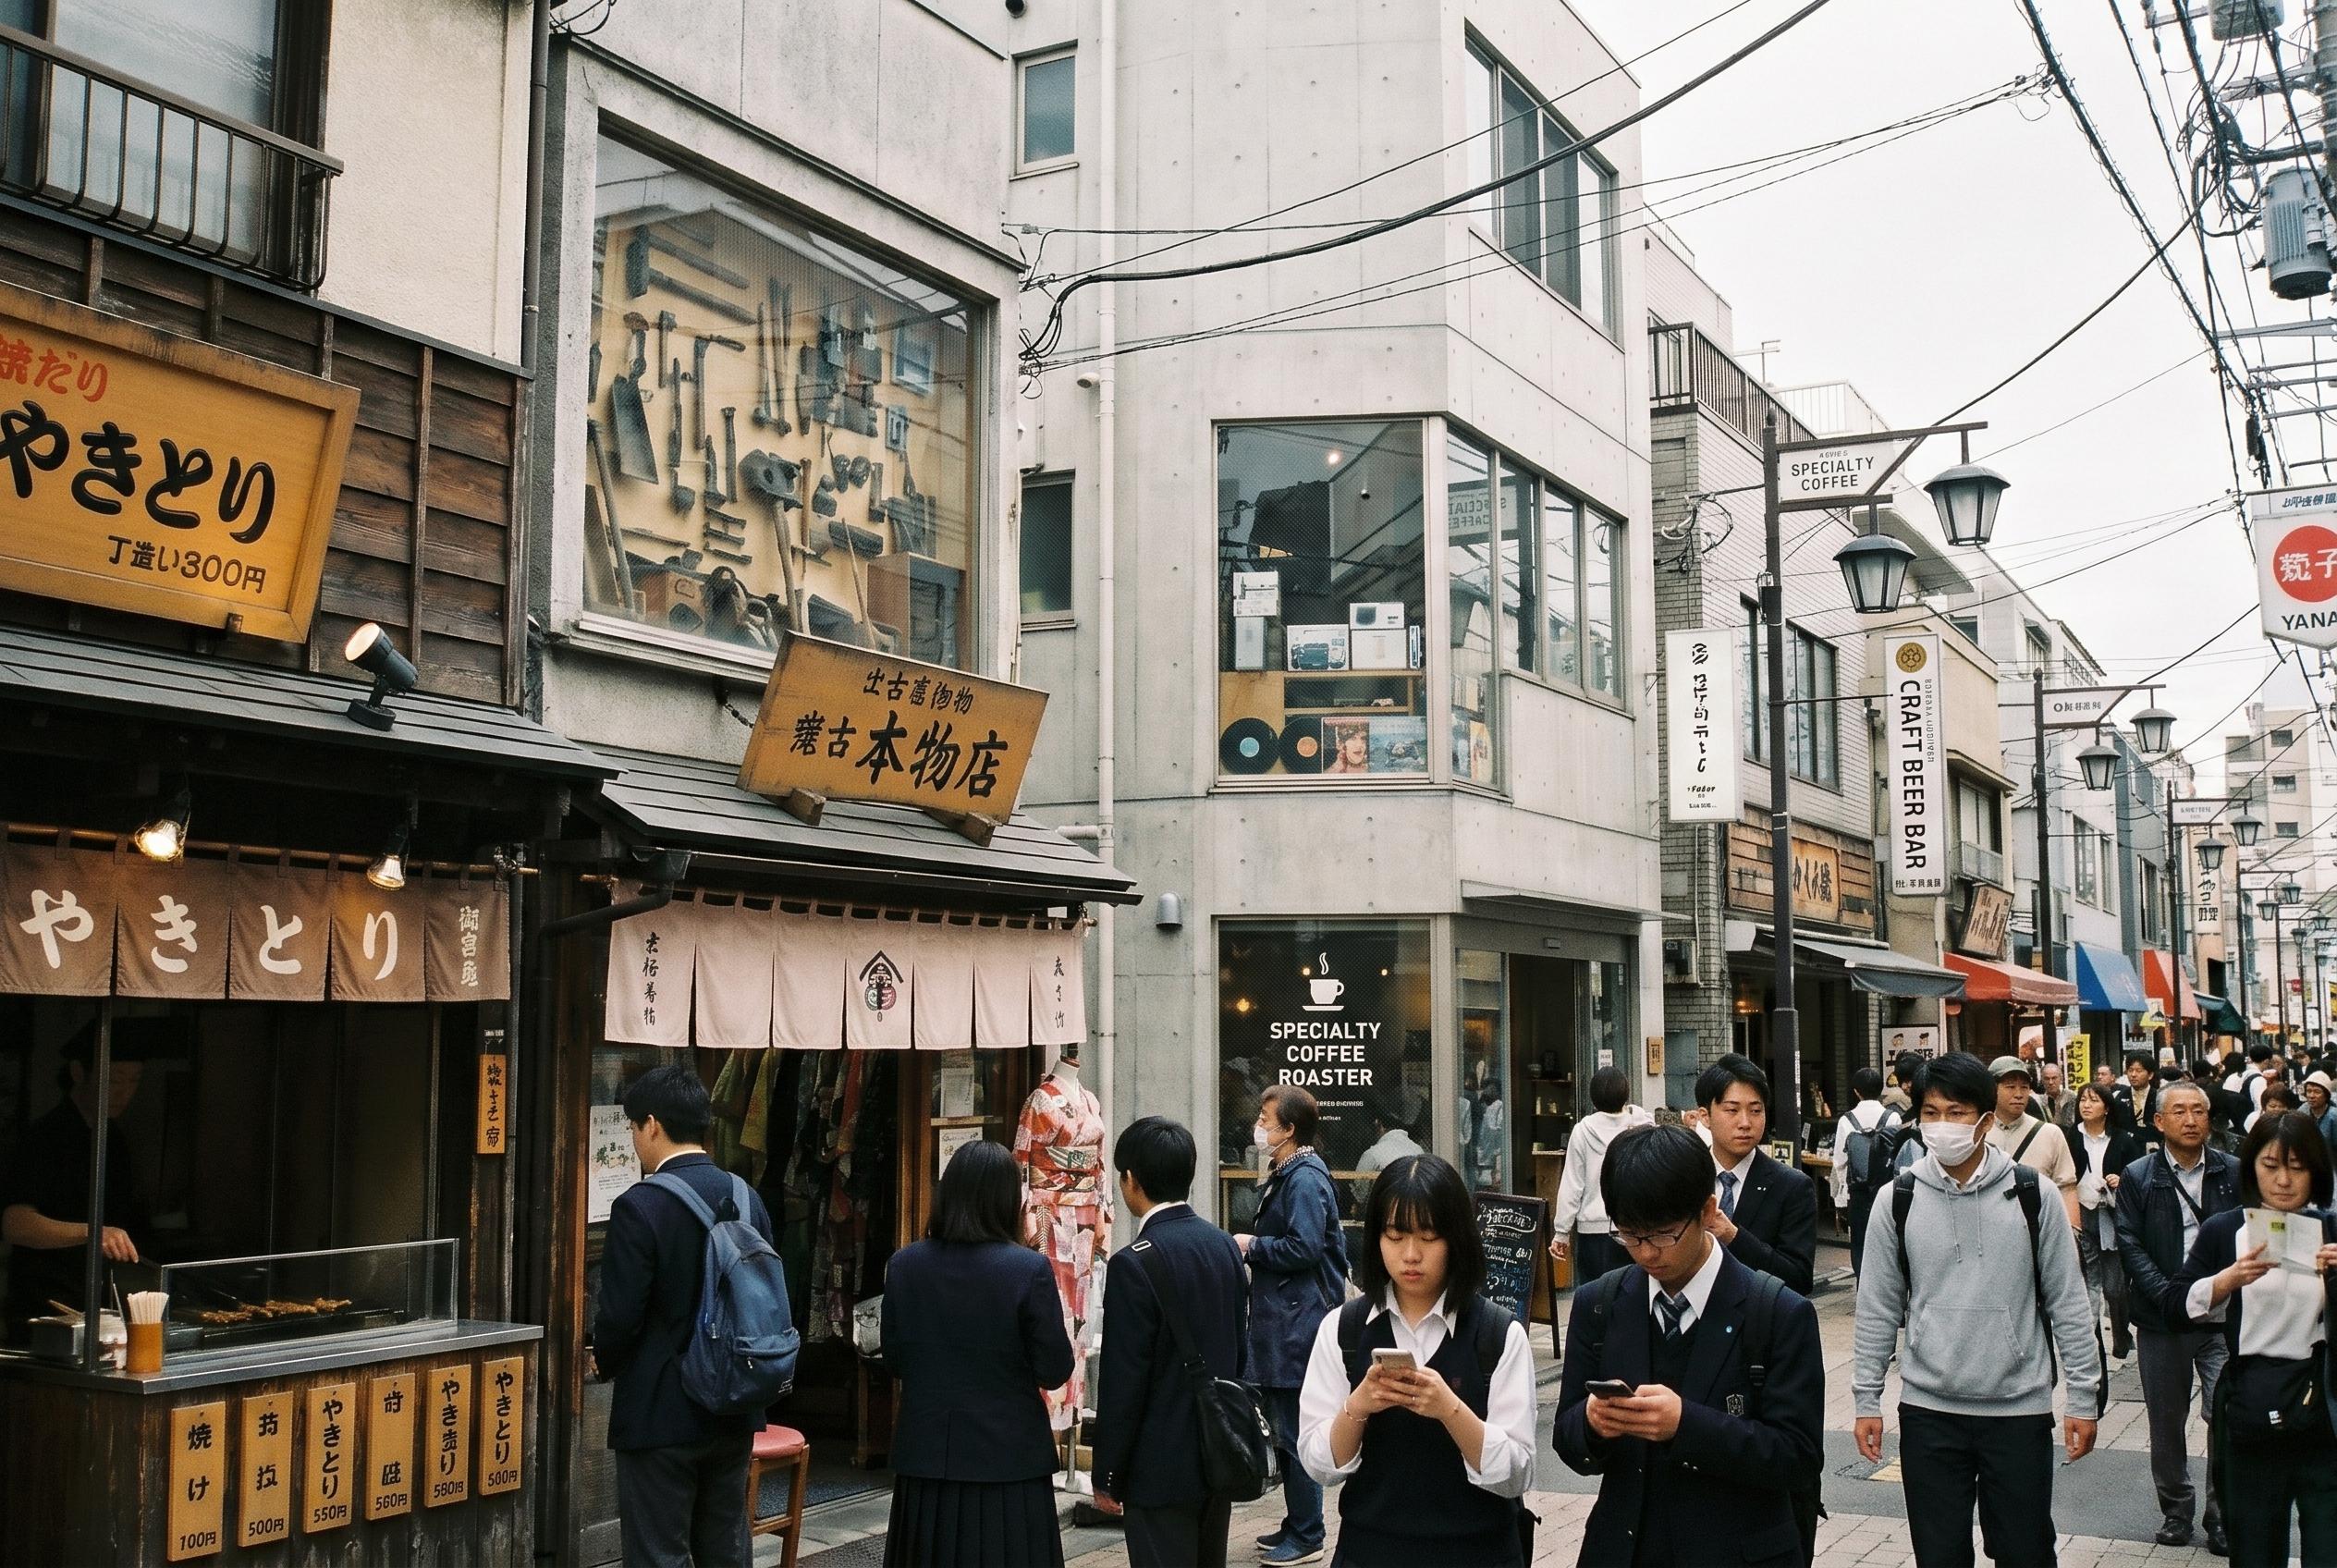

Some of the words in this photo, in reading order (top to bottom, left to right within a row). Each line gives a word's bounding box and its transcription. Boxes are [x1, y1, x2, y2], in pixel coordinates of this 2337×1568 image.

[0, 400, 275, 544] やきとり
[1792, 456, 1874, 476] SPECIALTY
[1802, 474, 1858, 491] COFFEE
[1900, 680, 1922, 753] CRAFT
[1903, 759, 1925, 816] BEER
[1904, 825, 1927, 869] BAR
[19, 888, 398, 981] やきとり
[1270, 1023, 1381, 1039] SPECIALTY
[1287, 1045, 1364, 1062] COFFEE
[1279, 1069, 1373, 1086] ROASTER
[496, 1371, 513, 1464] やきとり
[323, 1399, 343, 1500] やきとり
[188, 1422, 212, 1501] 焼け
[375, 1493, 408, 1511] 560円
[313, 1504, 347, 1524] 550円
[249, 1517, 284, 1537] 500円
[179, 1531, 216, 1551] 100円
